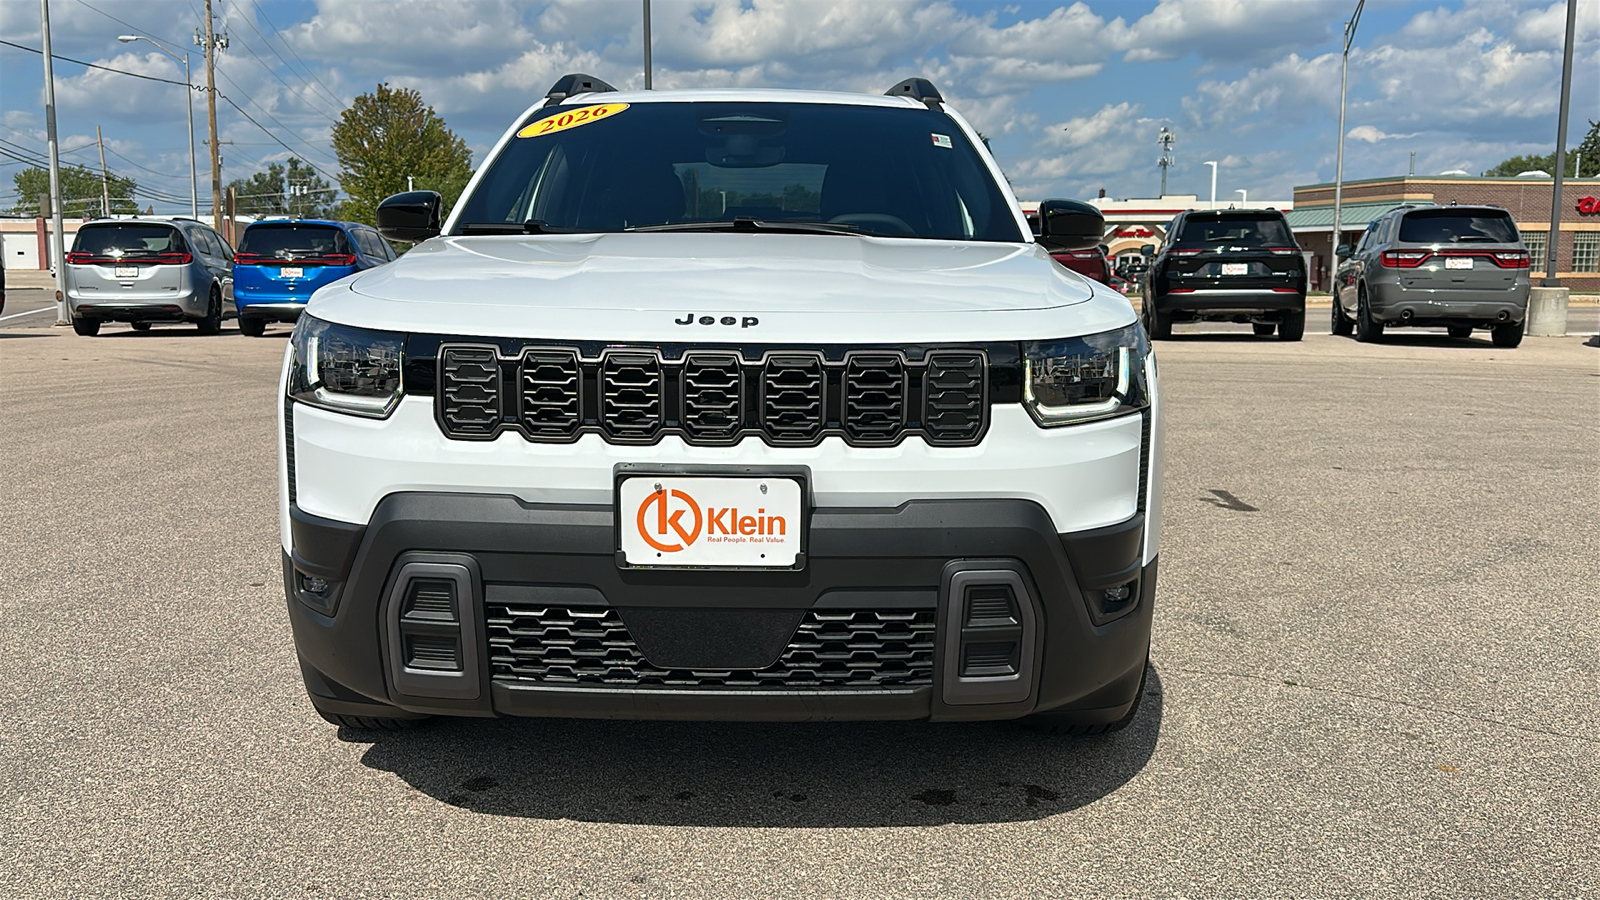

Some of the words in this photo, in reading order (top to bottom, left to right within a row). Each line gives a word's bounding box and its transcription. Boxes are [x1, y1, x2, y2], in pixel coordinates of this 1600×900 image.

[539, 105, 608, 134] 2026
[674, 313, 759, 328] Jeep
[707, 507, 786, 535] Klein
